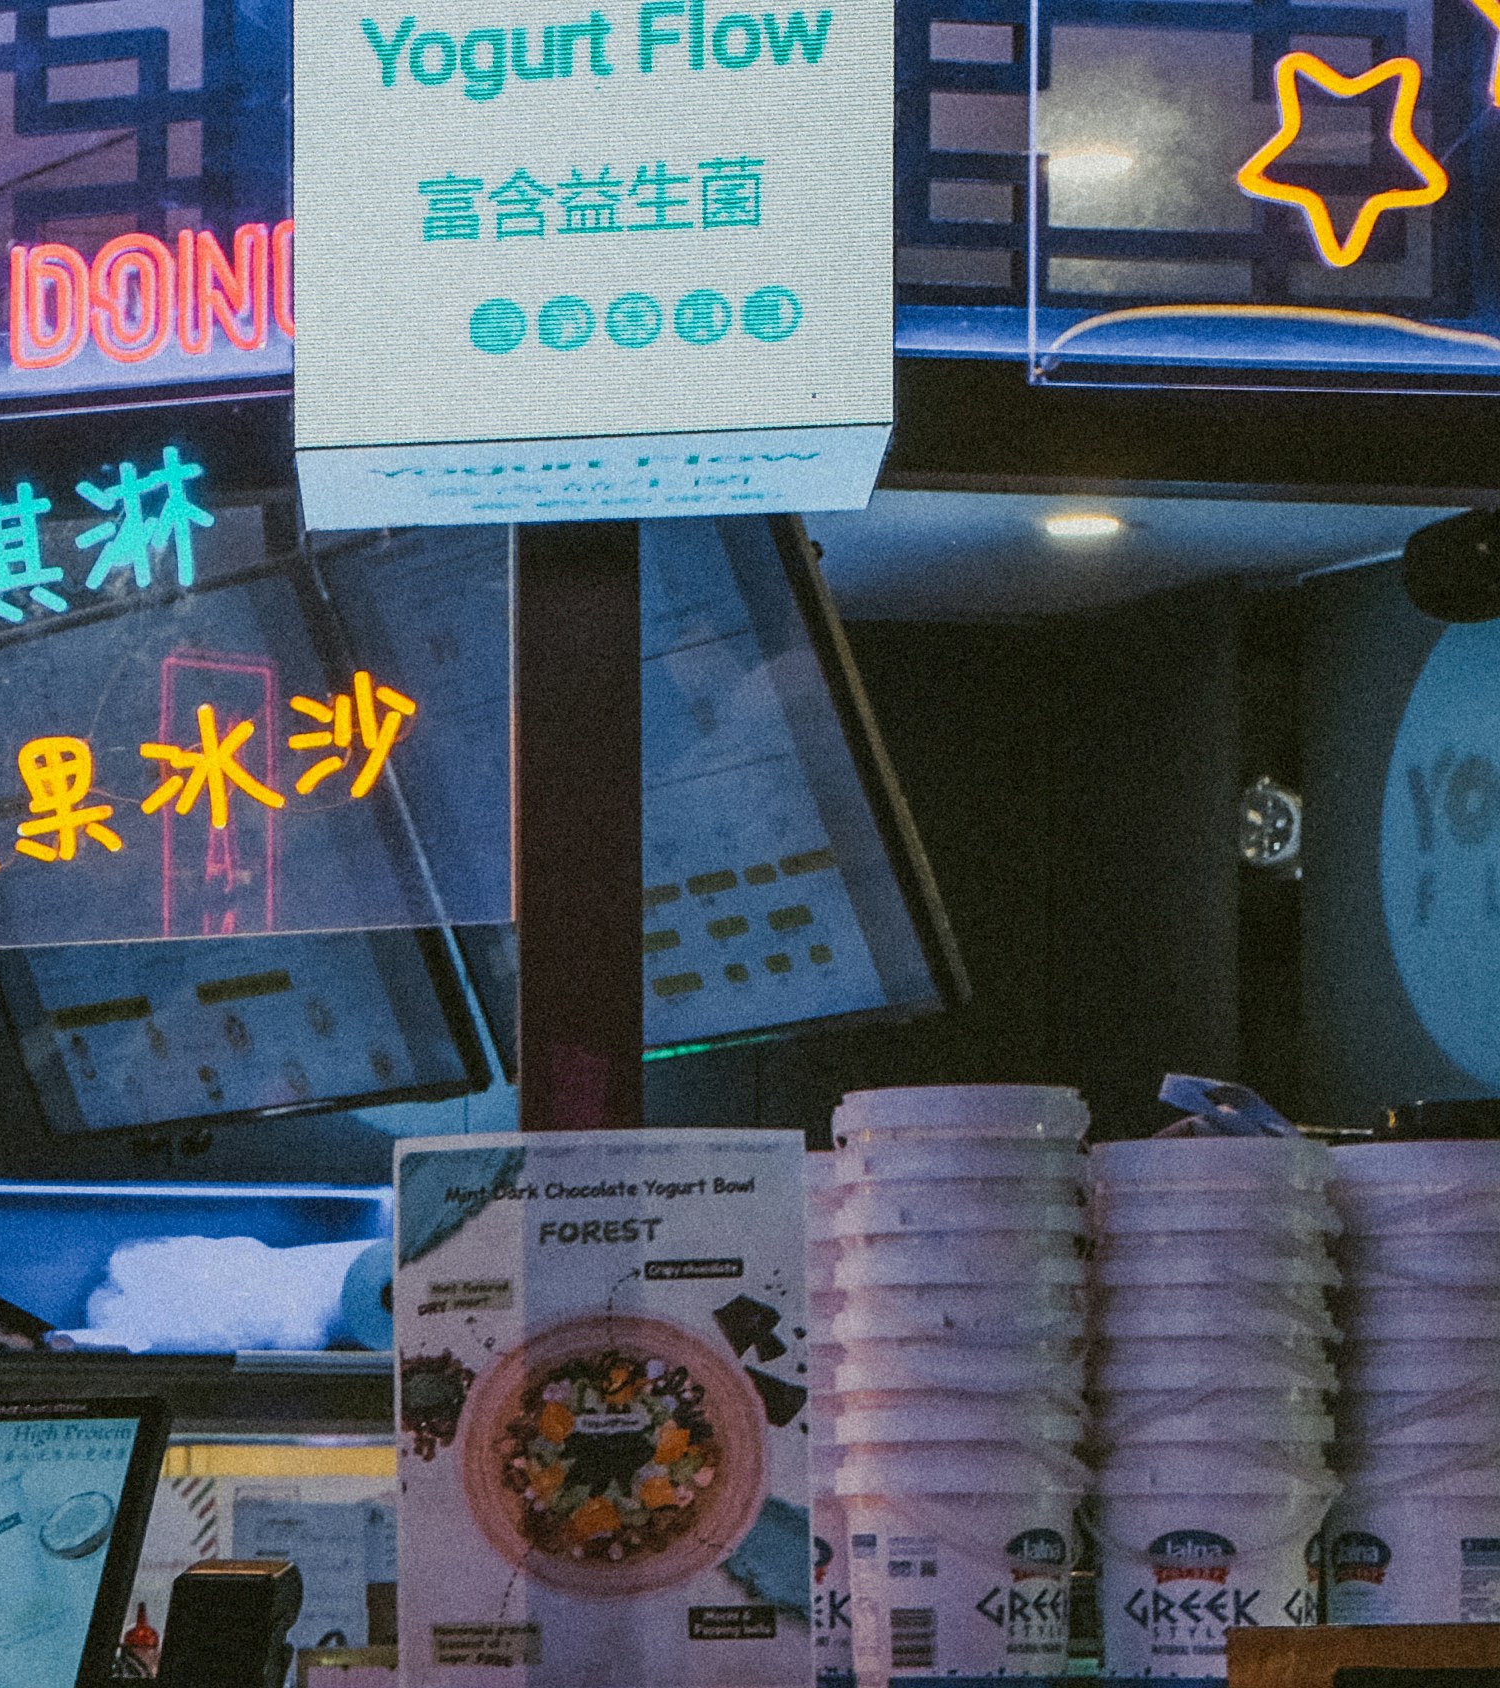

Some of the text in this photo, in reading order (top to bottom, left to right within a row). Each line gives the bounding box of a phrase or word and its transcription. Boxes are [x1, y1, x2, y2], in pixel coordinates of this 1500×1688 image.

[359, 0, 833, 103] Yogurt Flow
[417, 156, 766, 241] 富含益生菌
[493, 1185, 538, 1200] Dark
[545, 1182, 638, 1200] Chocolate
[644, 1180, 707, 1200] Yogurt
[713, 1177, 756, 1195] Bowl
[539, 1217, 663, 1245] FOREST
[1124, 1588, 1261, 1629] GREEK
